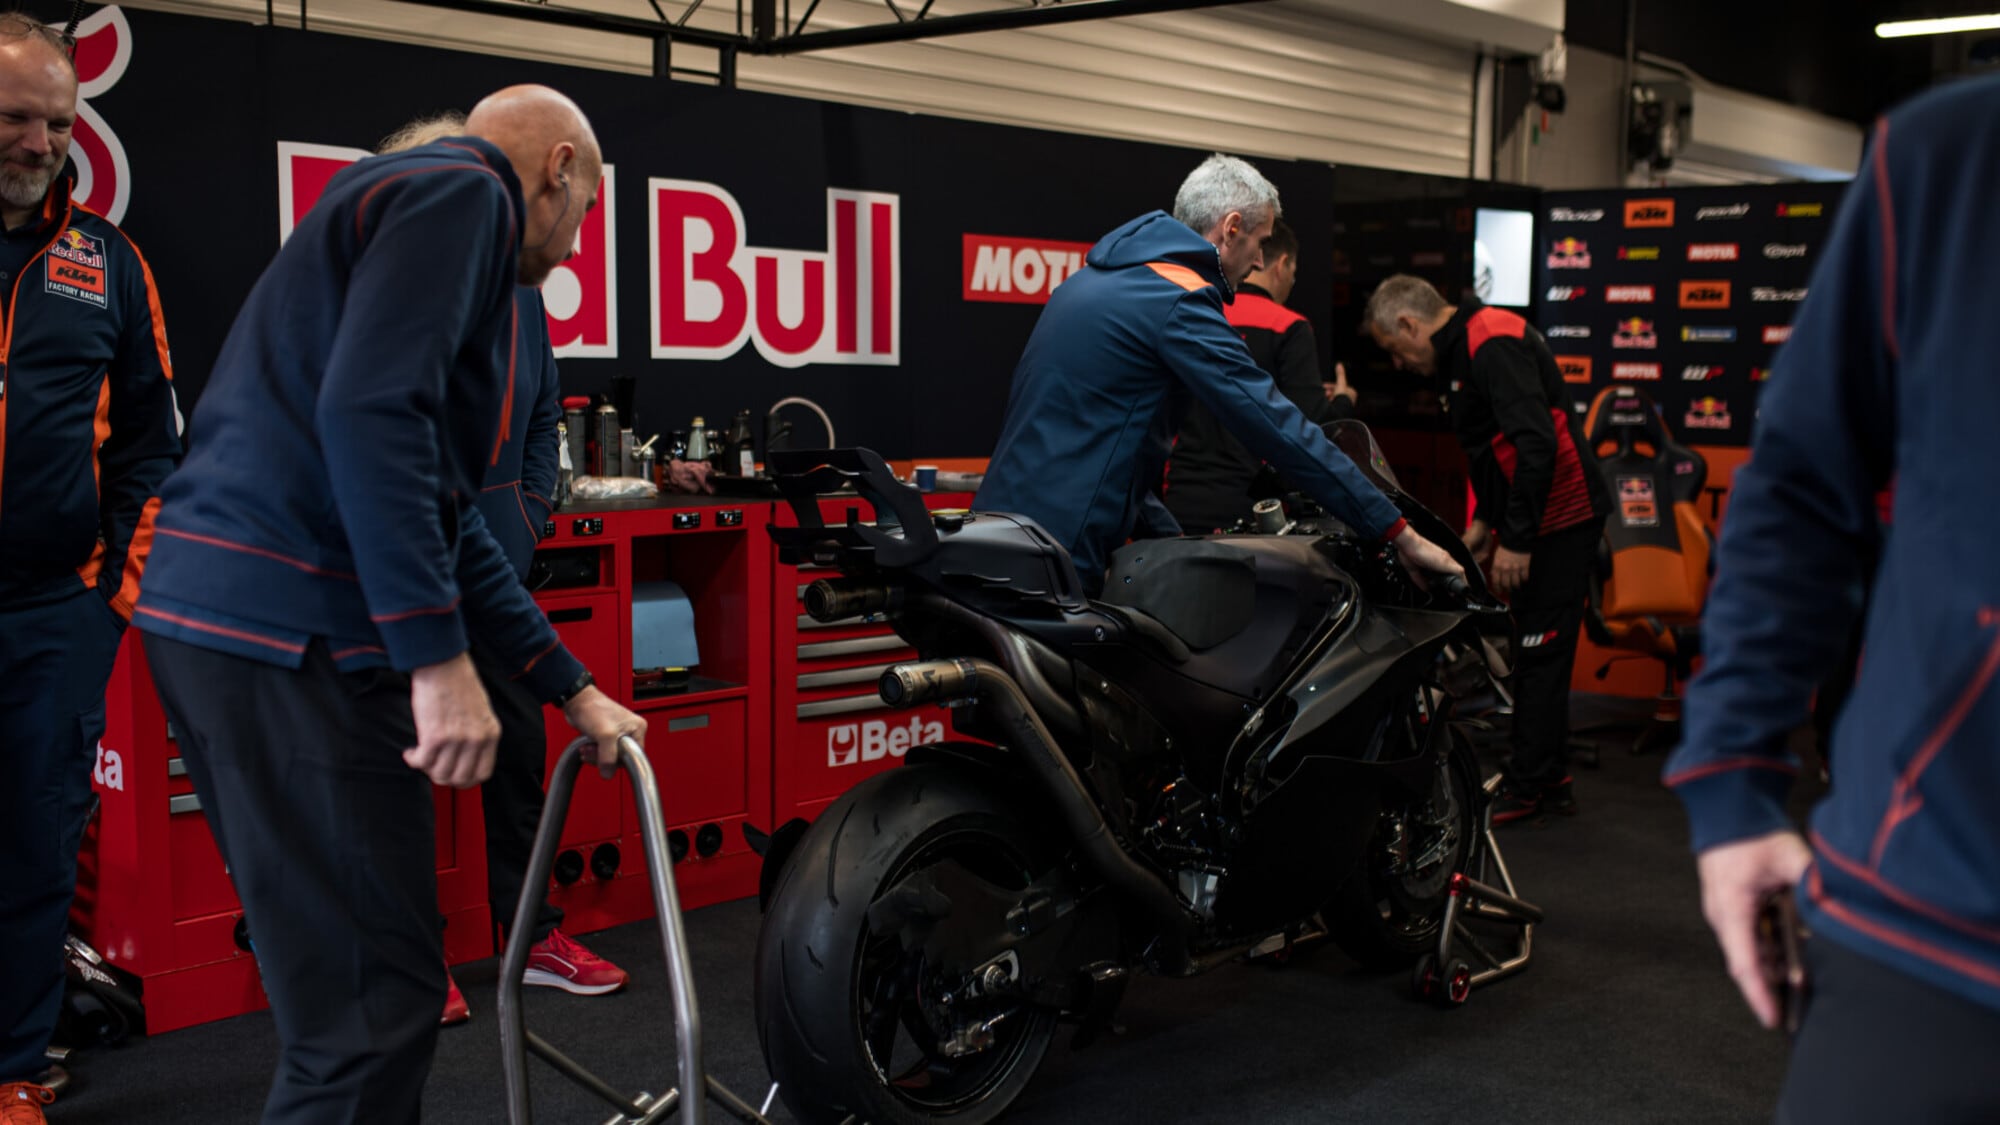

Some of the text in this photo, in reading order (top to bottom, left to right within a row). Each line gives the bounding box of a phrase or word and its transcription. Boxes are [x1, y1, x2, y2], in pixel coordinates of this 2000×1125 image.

[56, 266, 96, 285] KTM
[76, 249, 104, 268] Bull
[652, 181, 897, 362] Bull
[969, 244, 1087, 295] MOT
[48, 281, 104, 304] FACTORY RACING
[861, 715, 945, 762] Beta
[94, 738, 124, 792] ta
